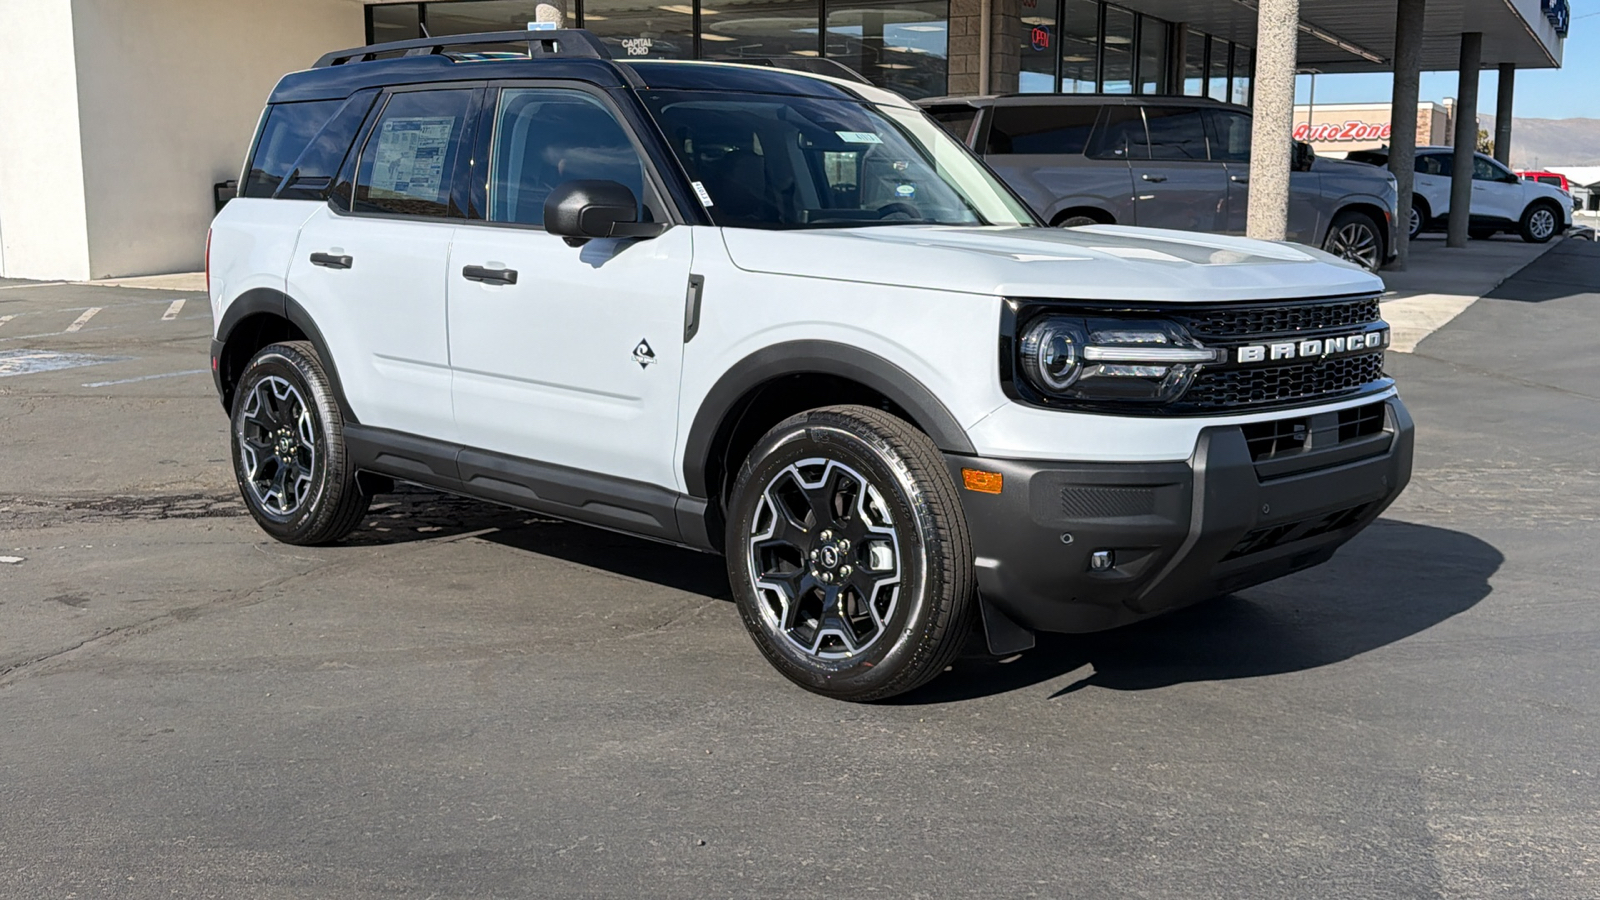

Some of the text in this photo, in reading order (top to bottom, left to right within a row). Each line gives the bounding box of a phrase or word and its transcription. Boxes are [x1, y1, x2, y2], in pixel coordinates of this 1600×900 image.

[621, 38, 653, 48] CAPITAL
[1031, 28, 1049, 47] OPEN
[627, 46, 649, 56] FORD
[1292, 121, 1391, 141] AutoZone
[1237, 332, 1381, 363] BRONCO
